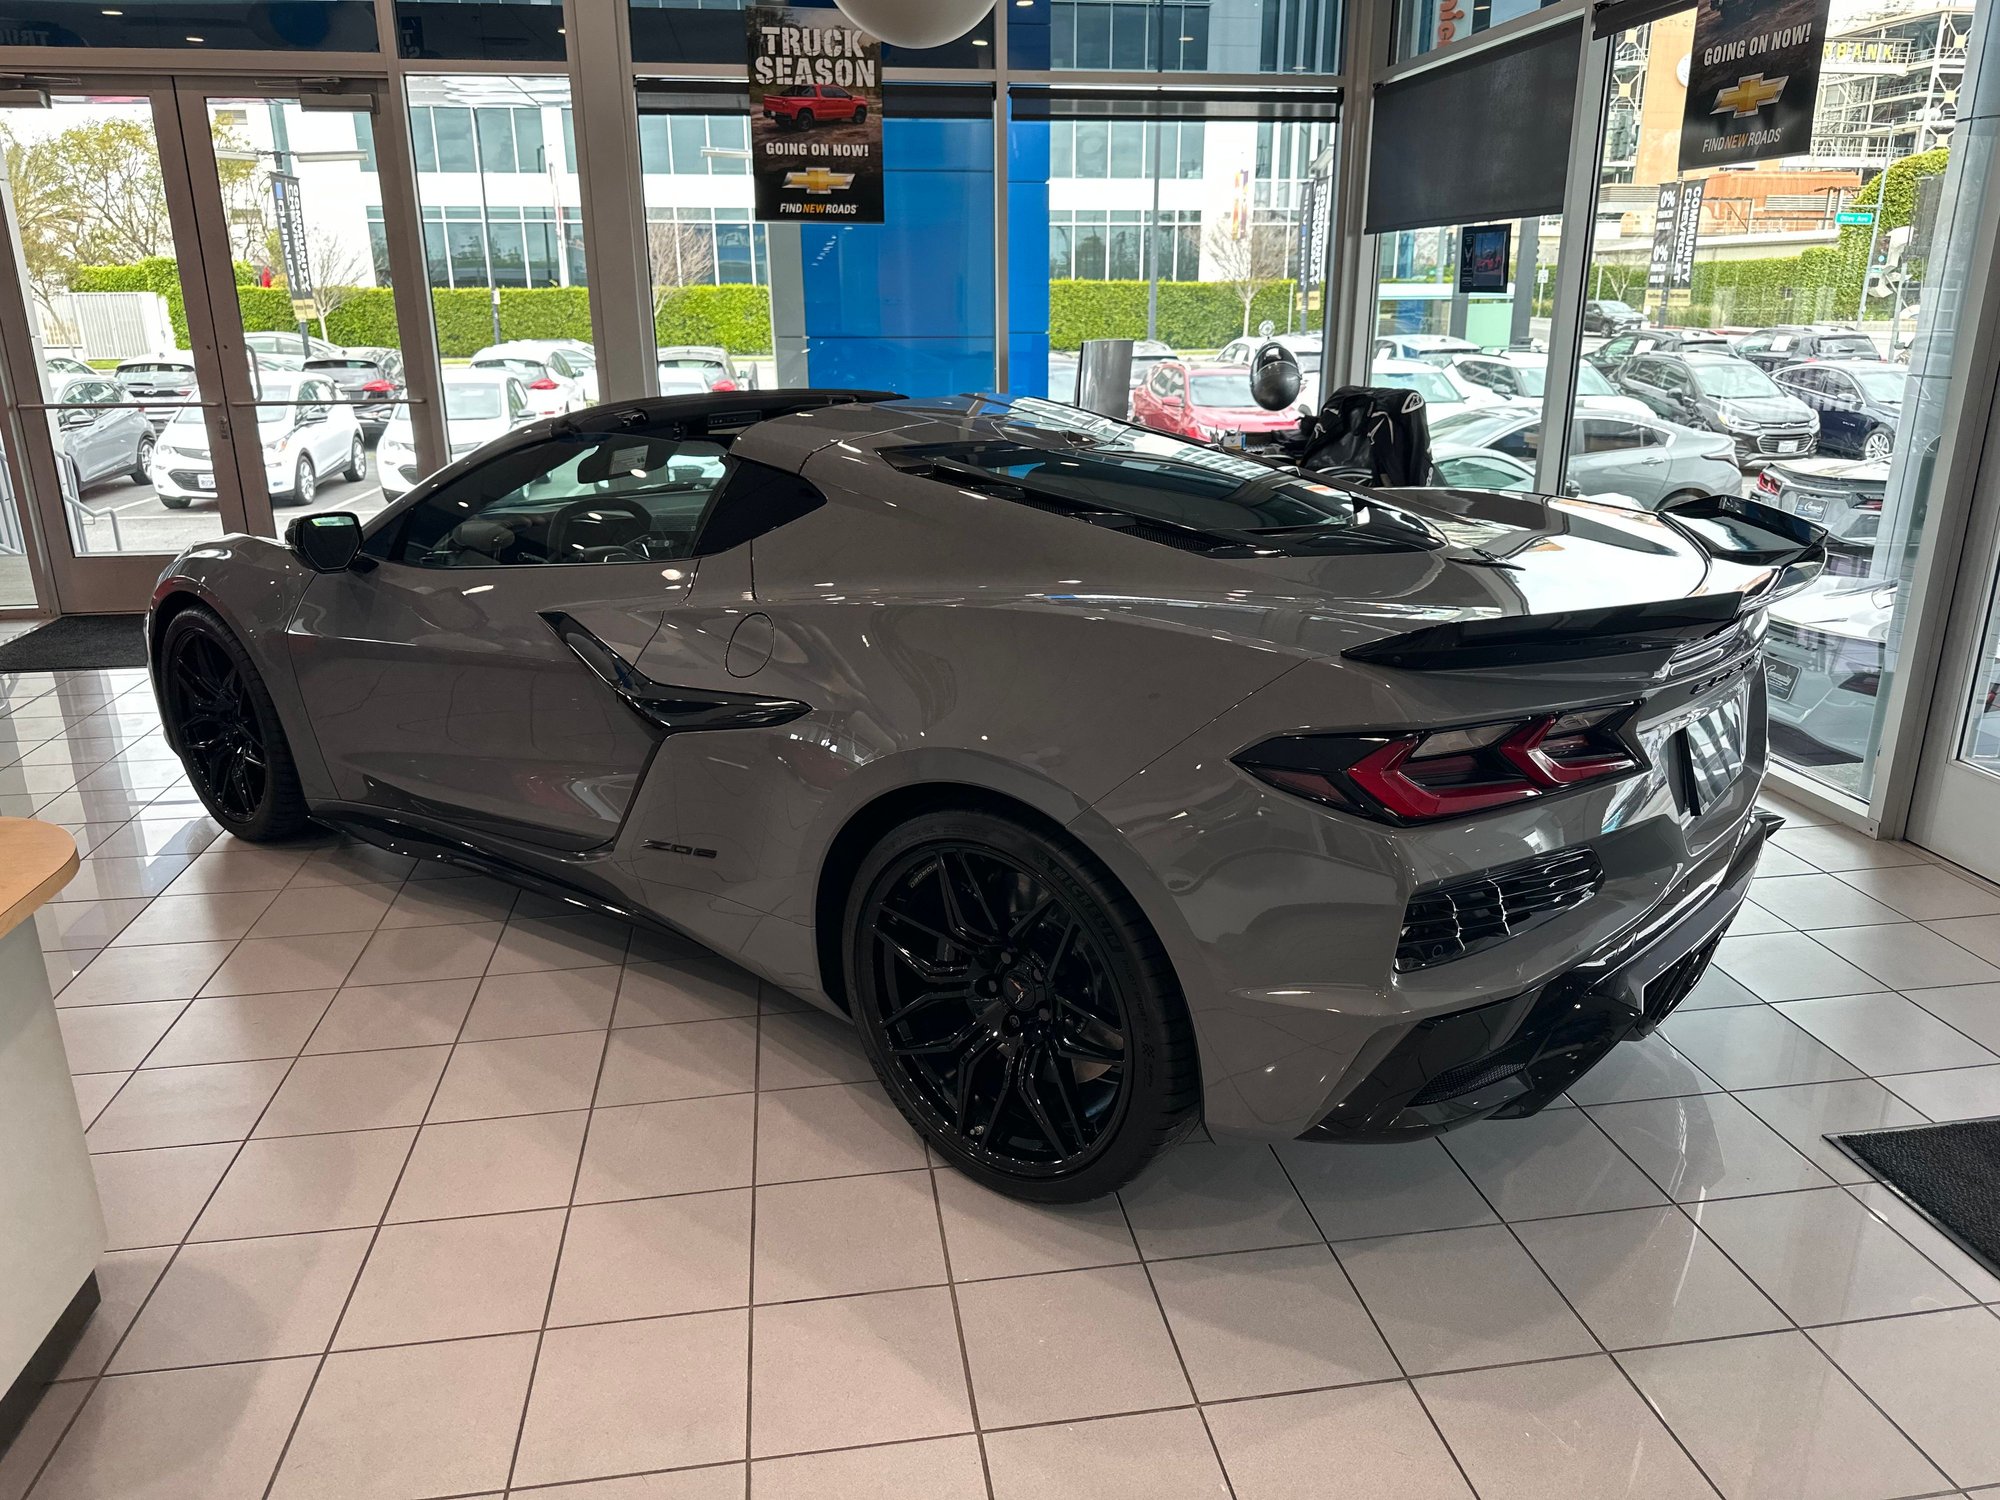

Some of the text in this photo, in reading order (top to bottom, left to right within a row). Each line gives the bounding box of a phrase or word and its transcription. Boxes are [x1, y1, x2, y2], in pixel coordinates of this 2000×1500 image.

[761, 26, 865, 57] TRUCK
[1703, 22, 1812, 67] GOING ON NOW!
[1823, 41, 1894, 63] RBANK
[755, 56, 875, 88] SEASON
[765, 142, 869, 157] GOING ON NOW!
[1702, 129, 1782, 153] FIND NEW ROADS
[779, 203, 857, 215] FIND NEW ROADS
[1660, 190, 1676, 209] 0%
[1673, 188, 1693, 284] CHEVROLET
[1681, 186, 1702, 283] COMMUNITY
[1653, 244, 1669, 262] 0%
[640, 838, 718, 859] Z06
[1052, 865, 1126, 953] MICHELIN
